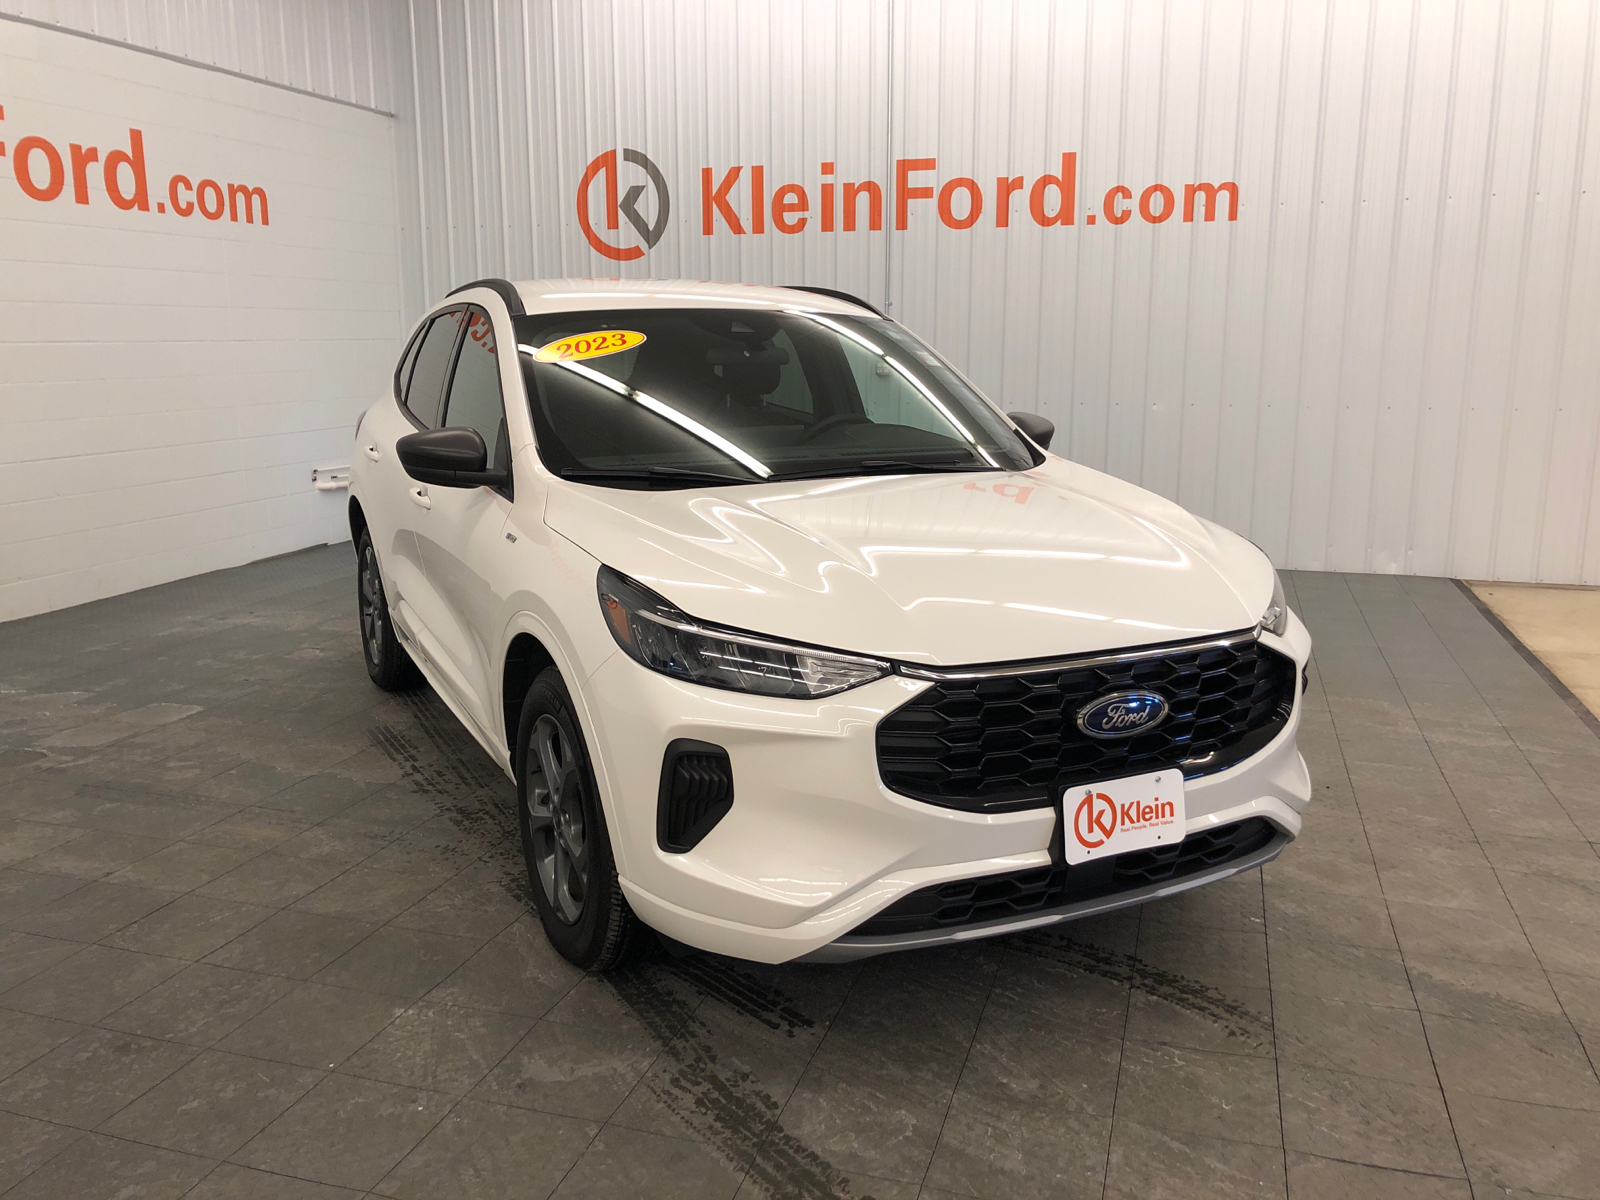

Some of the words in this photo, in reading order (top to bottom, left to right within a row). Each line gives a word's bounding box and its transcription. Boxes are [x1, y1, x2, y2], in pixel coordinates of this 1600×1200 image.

[0, 105, 269, 226] ord.com
[701, 151, 1239, 236] KleinFord.com
[556, 333, 627, 359] 2023
[1101, 703, 1151, 730] Ford
[1120, 796, 1175, 826] Klein
[1149, 820, 1160, 828] Real
